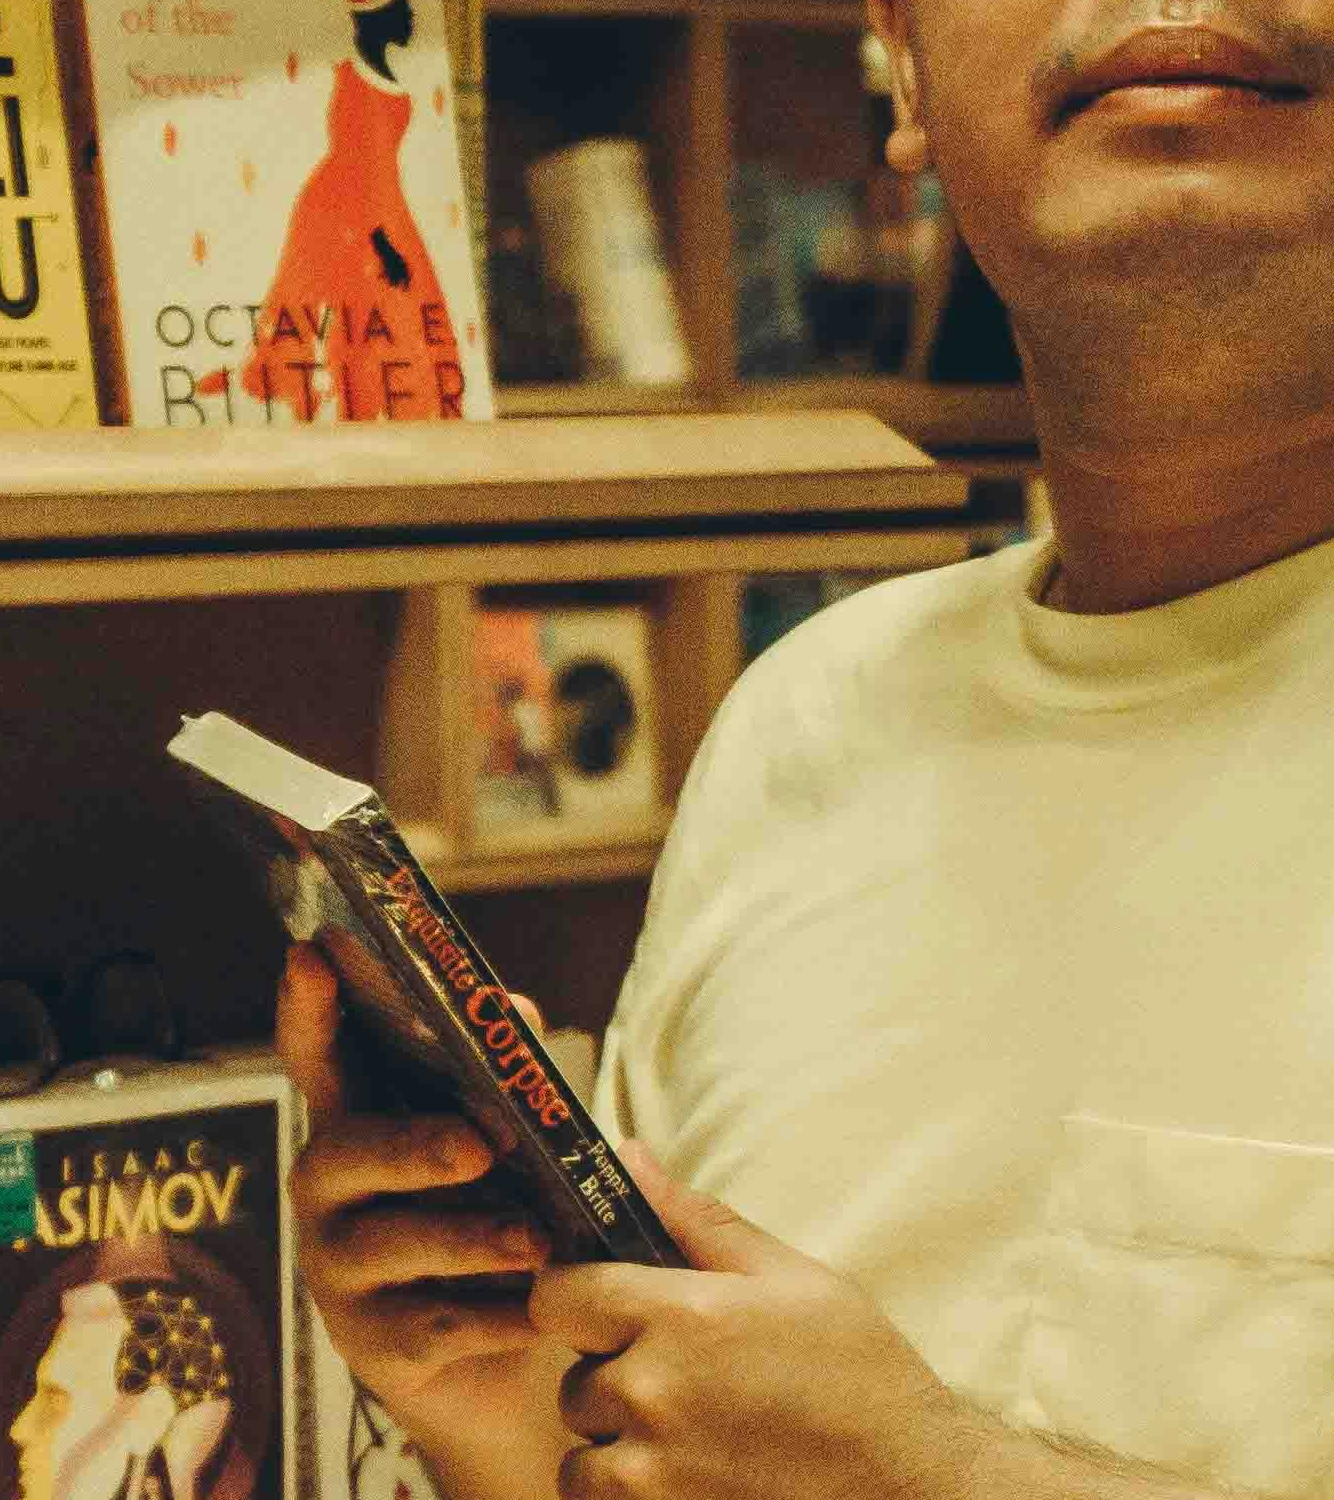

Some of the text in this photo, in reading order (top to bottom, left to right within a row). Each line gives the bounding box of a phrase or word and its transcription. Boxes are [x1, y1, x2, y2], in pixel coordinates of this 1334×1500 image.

[154, 303, 394, 348] OCTAVIA
[385, 865, 477, 991] Exquisite
[462, 983, 572, 1129] Corpse
[62, 1139, 206, 1182] ISAAC
[586, 1138, 633, 1199] Poppy
